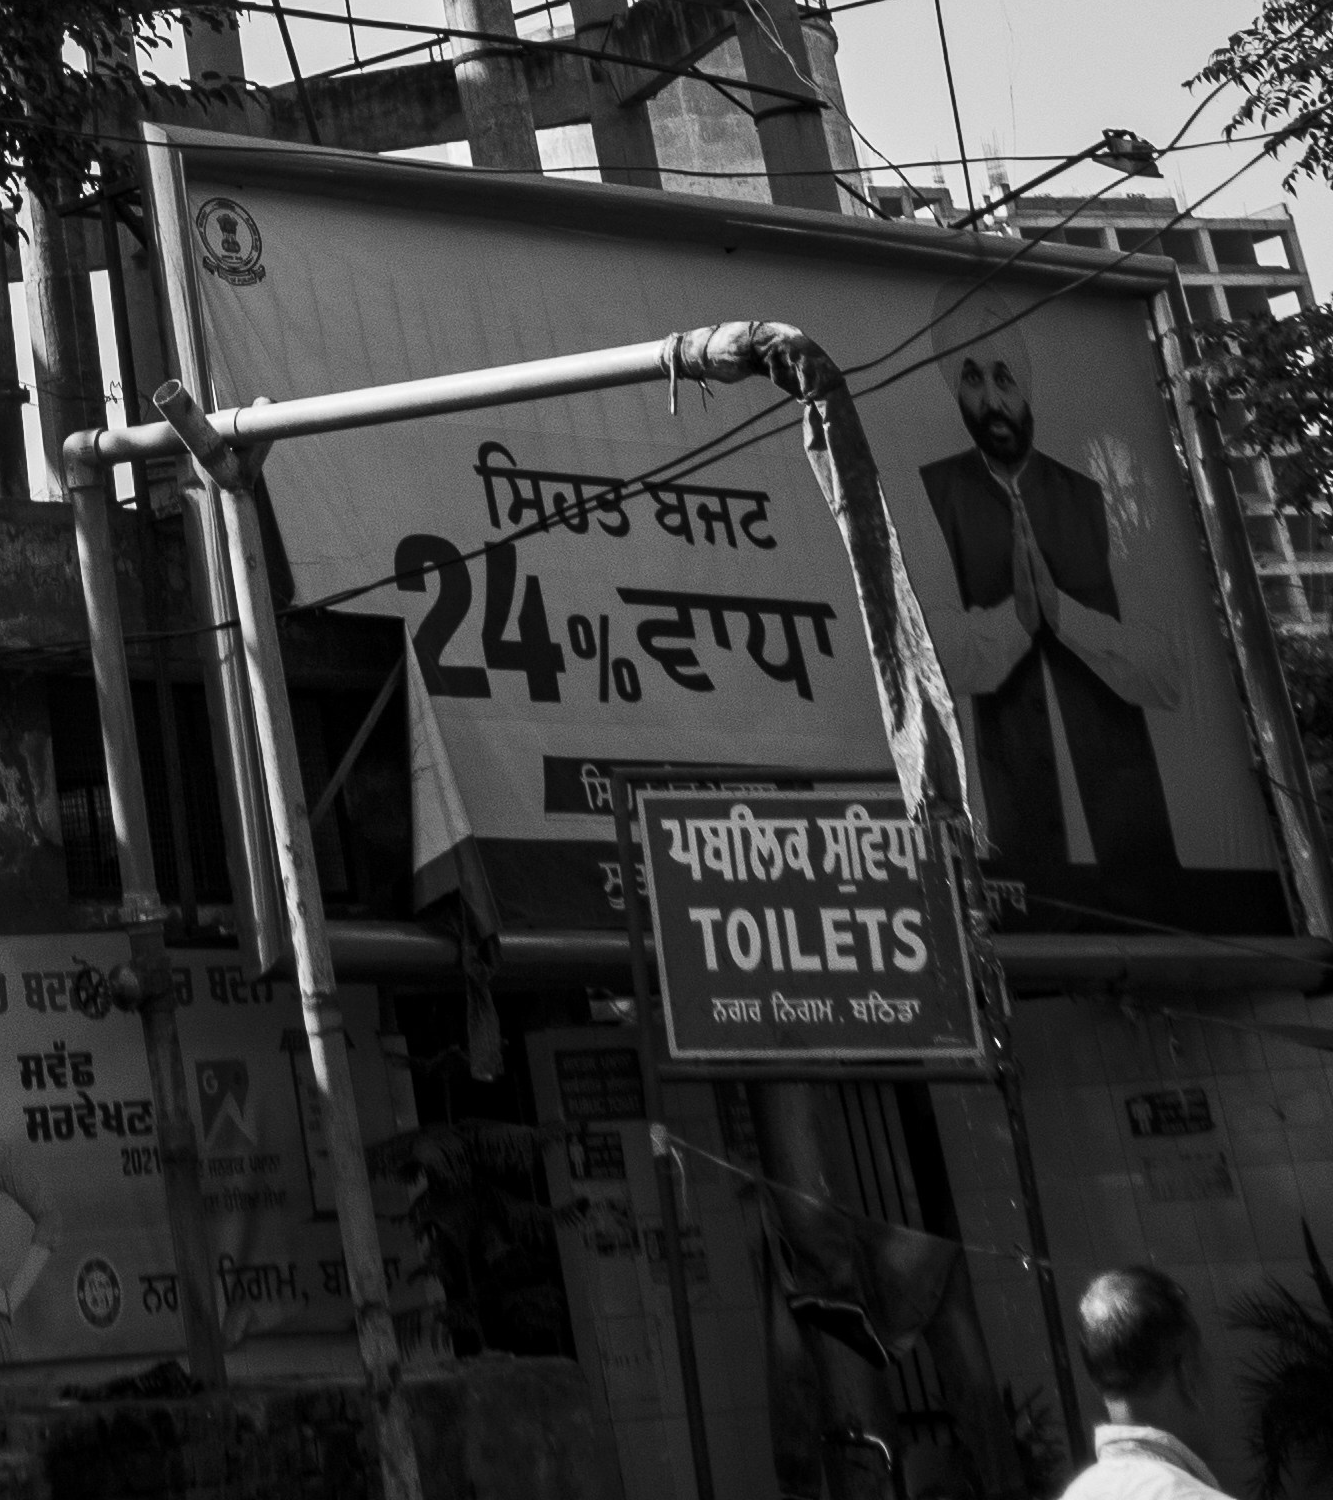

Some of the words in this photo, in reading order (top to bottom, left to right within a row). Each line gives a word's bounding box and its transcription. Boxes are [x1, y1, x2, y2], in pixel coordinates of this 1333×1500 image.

[640, 480, 778, 551] ਬਜਟ
[395, 533, 643, 704] 24%
[616, 587, 836, 703] ਵਾਧਾ
[660, 802, 816, 883] ਪਬਲਿਕ
[816, 802, 929, 895] ਸੁਵਿਧਾ
[687, 907, 930, 973] TOILETS
[711, 997, 763, 1025] ਨਗਰ
[16, 1040, 96, 1090] ਸਵੱਛ
[120, 1146, 164, 1177] 2021
